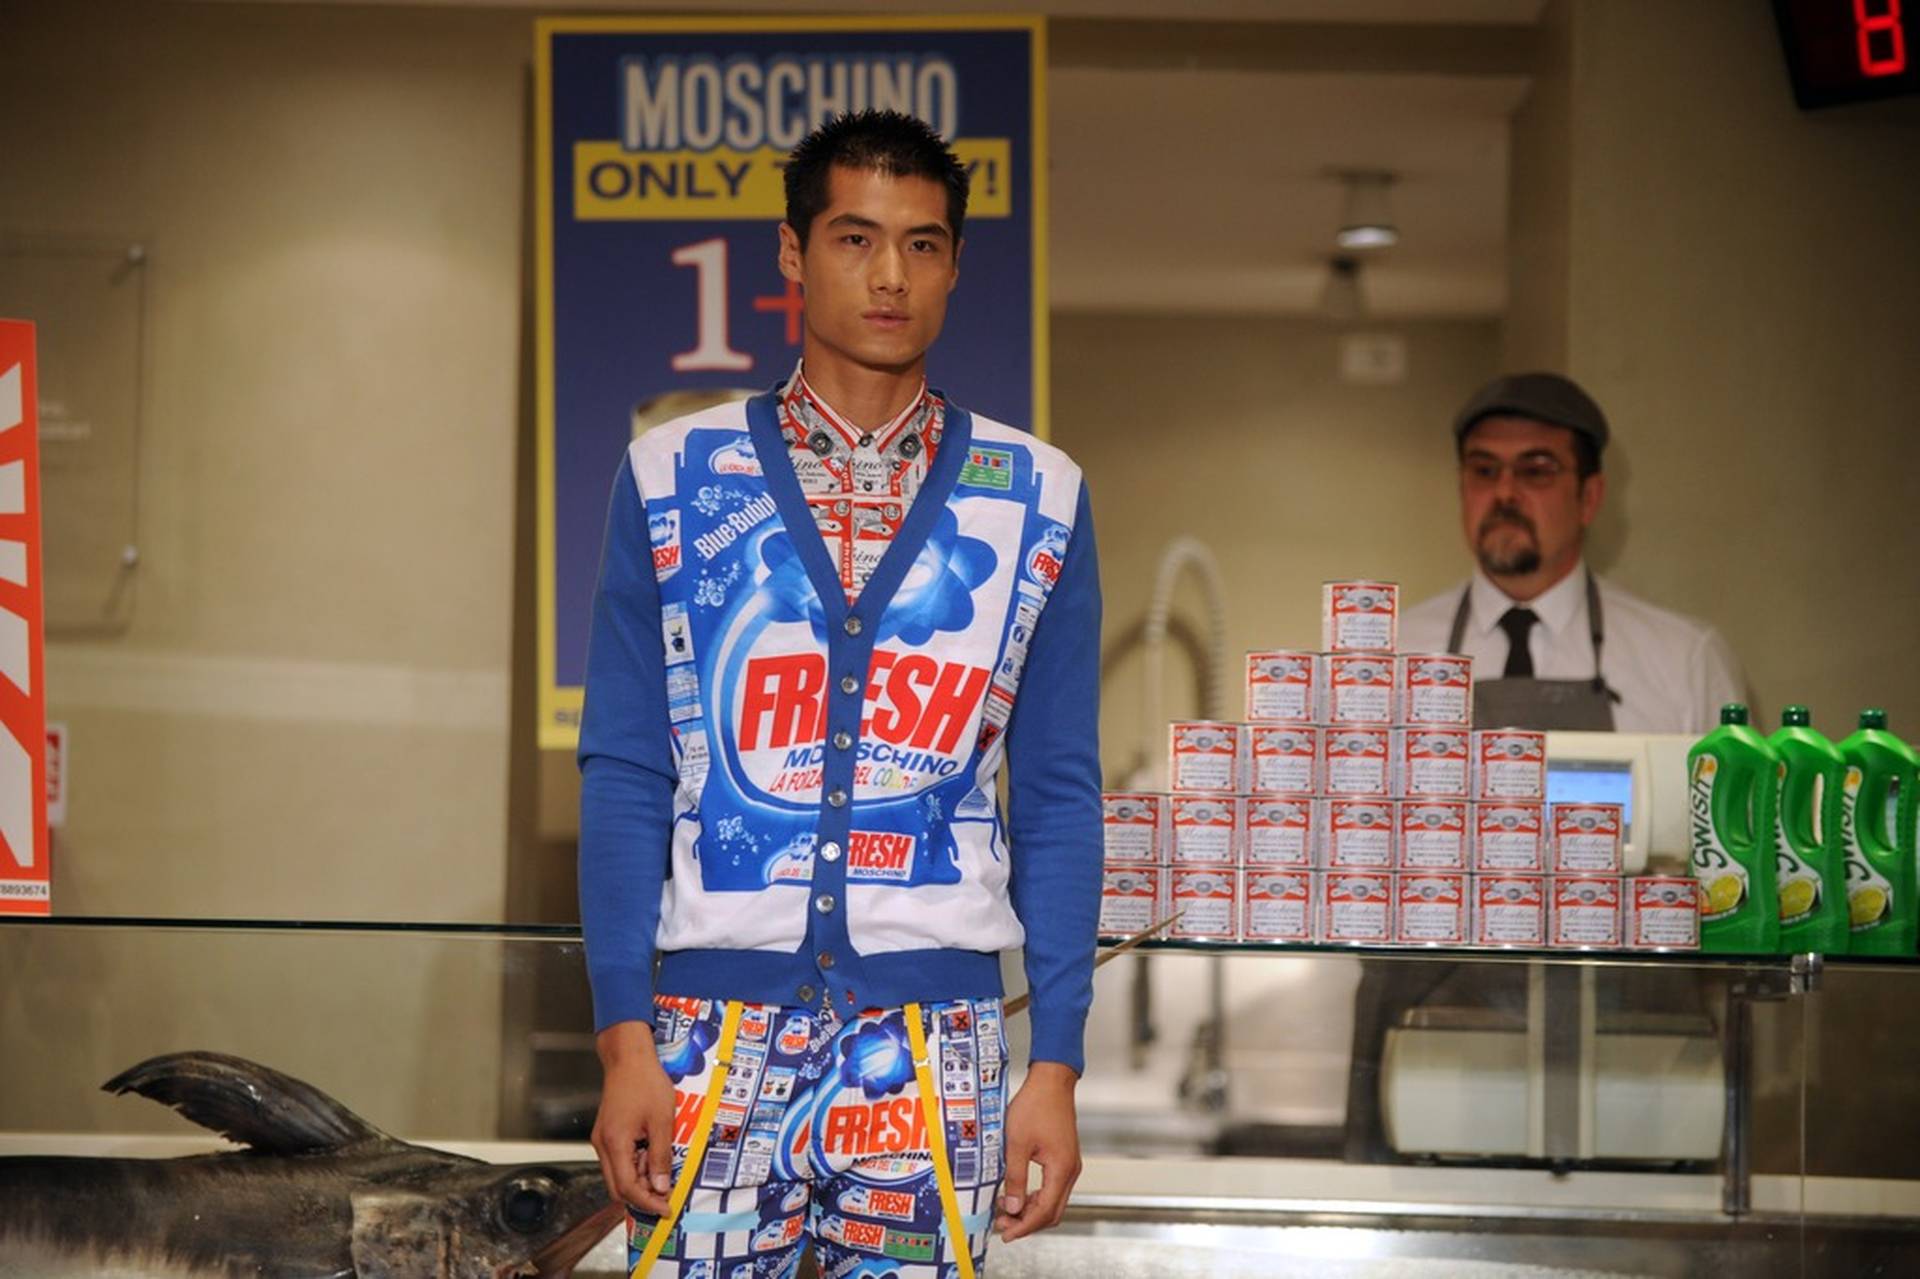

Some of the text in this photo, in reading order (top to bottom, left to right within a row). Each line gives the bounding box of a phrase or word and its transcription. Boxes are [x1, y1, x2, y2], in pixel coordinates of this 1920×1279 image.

[624, 58, 957, 150] MOSCHINO
[588, 160, 751, 199] ONLY
[739, 649, 991, 755] FRESH
[783, 742, 959, 775] MOSCHINO
[824, 1096, 939, 1155] FRESH
[851, 1151, 934, 1165] MOSCHIN
[868, 1188, 913, 1217] FRESH
[843, 1220, 884, 1248] FRESH
